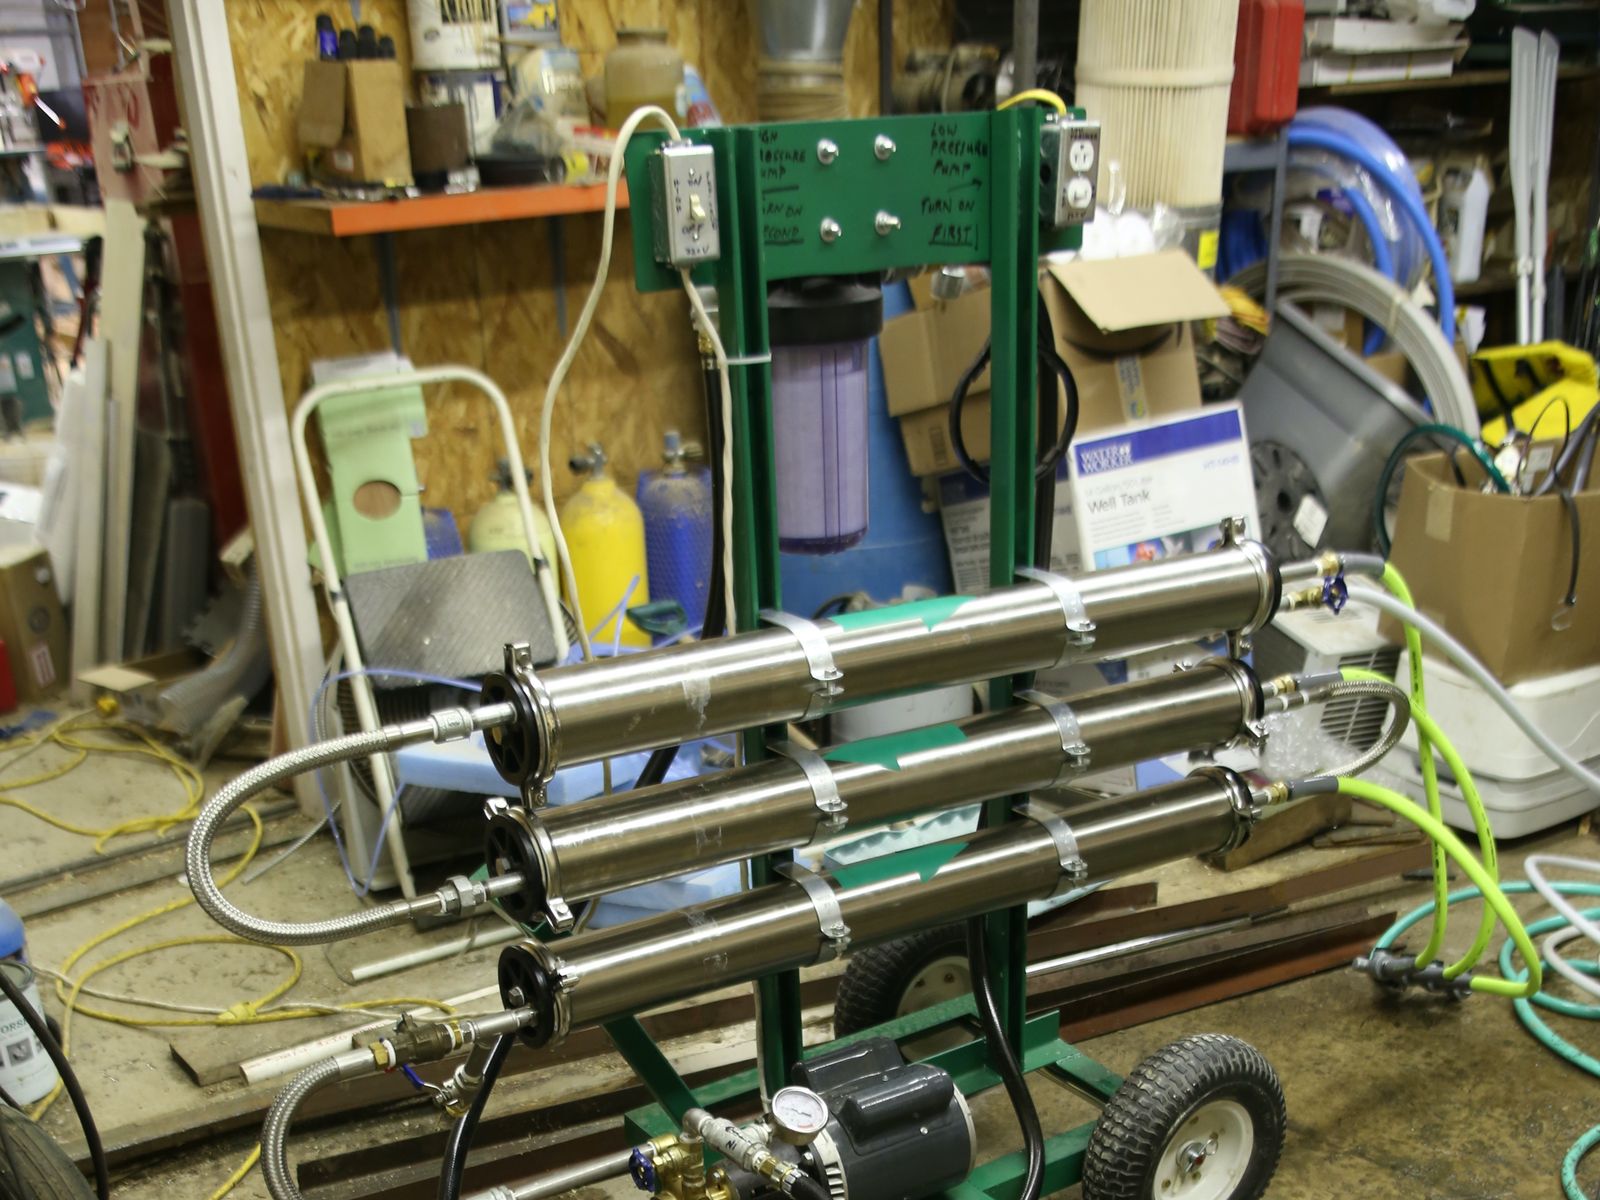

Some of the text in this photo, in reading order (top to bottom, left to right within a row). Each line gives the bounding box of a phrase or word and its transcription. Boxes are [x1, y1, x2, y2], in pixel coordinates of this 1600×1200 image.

[930, 121, 958, 137] LOW
[932, 159, 972, 178] PUMP
[921, 195, 976, 216] TURN ON
[1086, 496, 1117, 515] Well
[1119, 488, 1151, 507] Tank
